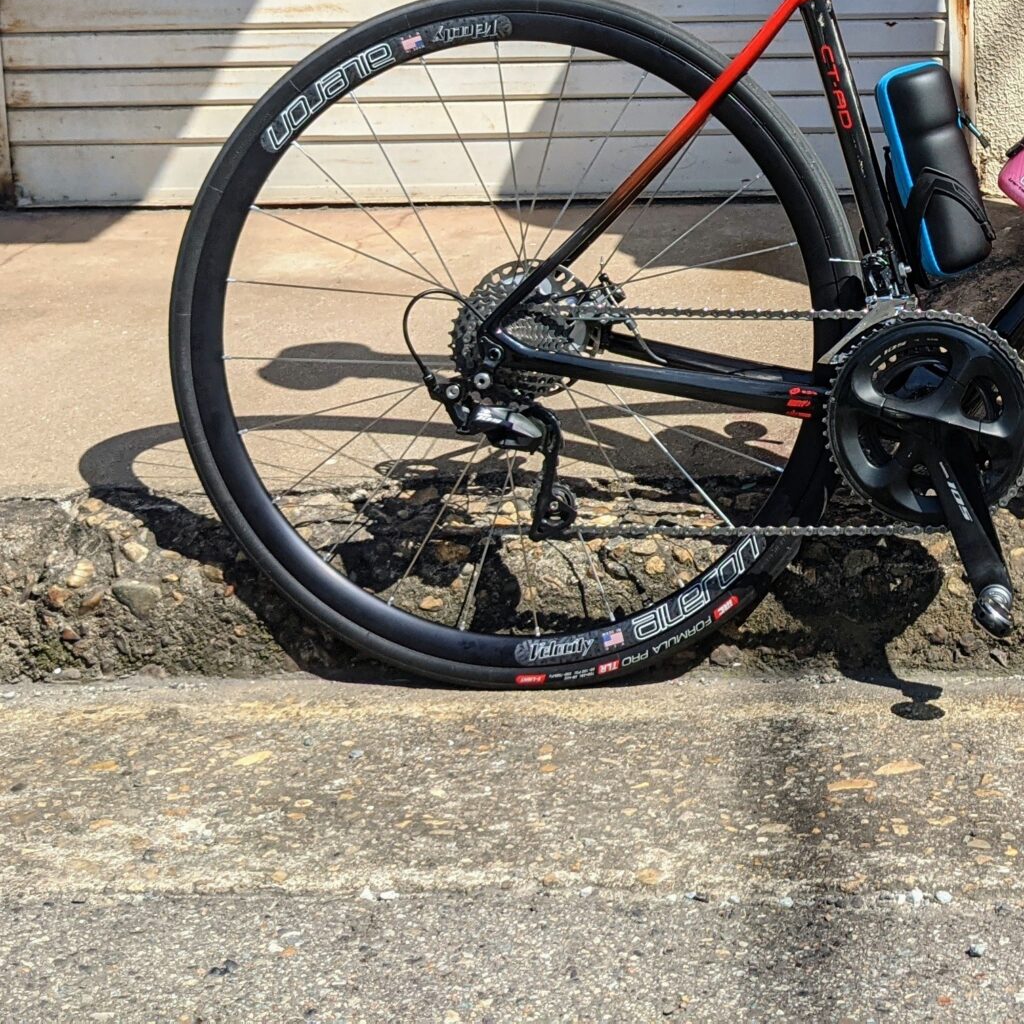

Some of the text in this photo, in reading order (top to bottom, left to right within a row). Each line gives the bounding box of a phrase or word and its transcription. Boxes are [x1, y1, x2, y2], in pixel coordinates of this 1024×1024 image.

[266, 42, 396, 151] aileron
[632, 534, 760, 641] aileron
[652, 614, 713, 655] FORMULA
[598, 662, 618, 674] TLR
[621, 648, 649, 667] PRO
